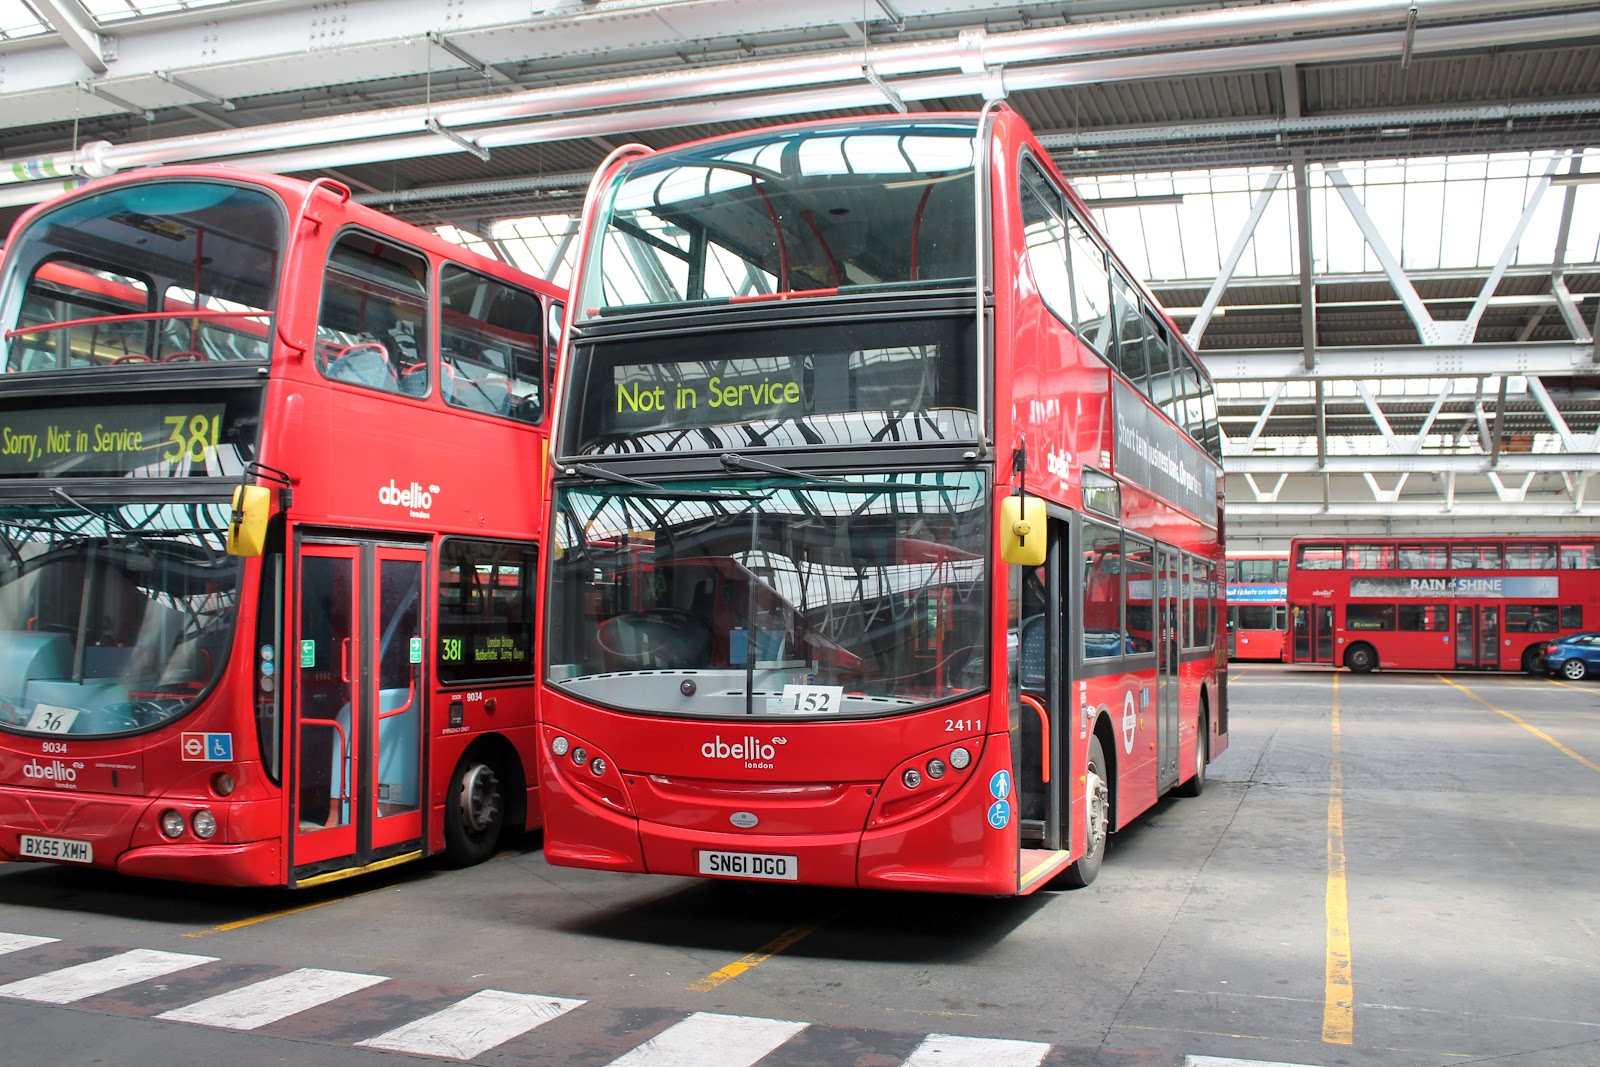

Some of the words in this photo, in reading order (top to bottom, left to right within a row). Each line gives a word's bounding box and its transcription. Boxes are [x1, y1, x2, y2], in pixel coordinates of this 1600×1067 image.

[617, 382, 665, 413] Not
[676, 383, 697, 409] in
[708, 376, 800, 408] Service
[2, 427, 43, 462] Sorry,
[47, 426, 71, 454] Not
[76, 430, 89, 452] in
[92, 424, 143, 453] Service
[163, 414, 220, 463] 381
[379, 479, 432, 510] abellio
[409, 510, 430, 520] london
[1410, 578, 1446, 591] RAIN
[1459, 578, 1502, 591] SHINE
[442, 639, 462, 661] 381
[466, 692, 482, 702] 9034
[794, 692, 830, 712] 152
[37, 712, 65, 732] 36
[944, 719, 982, 732] 2411
[42, 742, 68, 754] 9034
[701, 735, 775, 761] abellio
[23, 759, 77, 782] abellio
[744, 761, 774, 769] london
[26, 838, 59, 857] BX55
[62, 841, 87, 861] XMH
[709, 854, 747, 872] SN61
[752, 857, 786, 876] DGO
